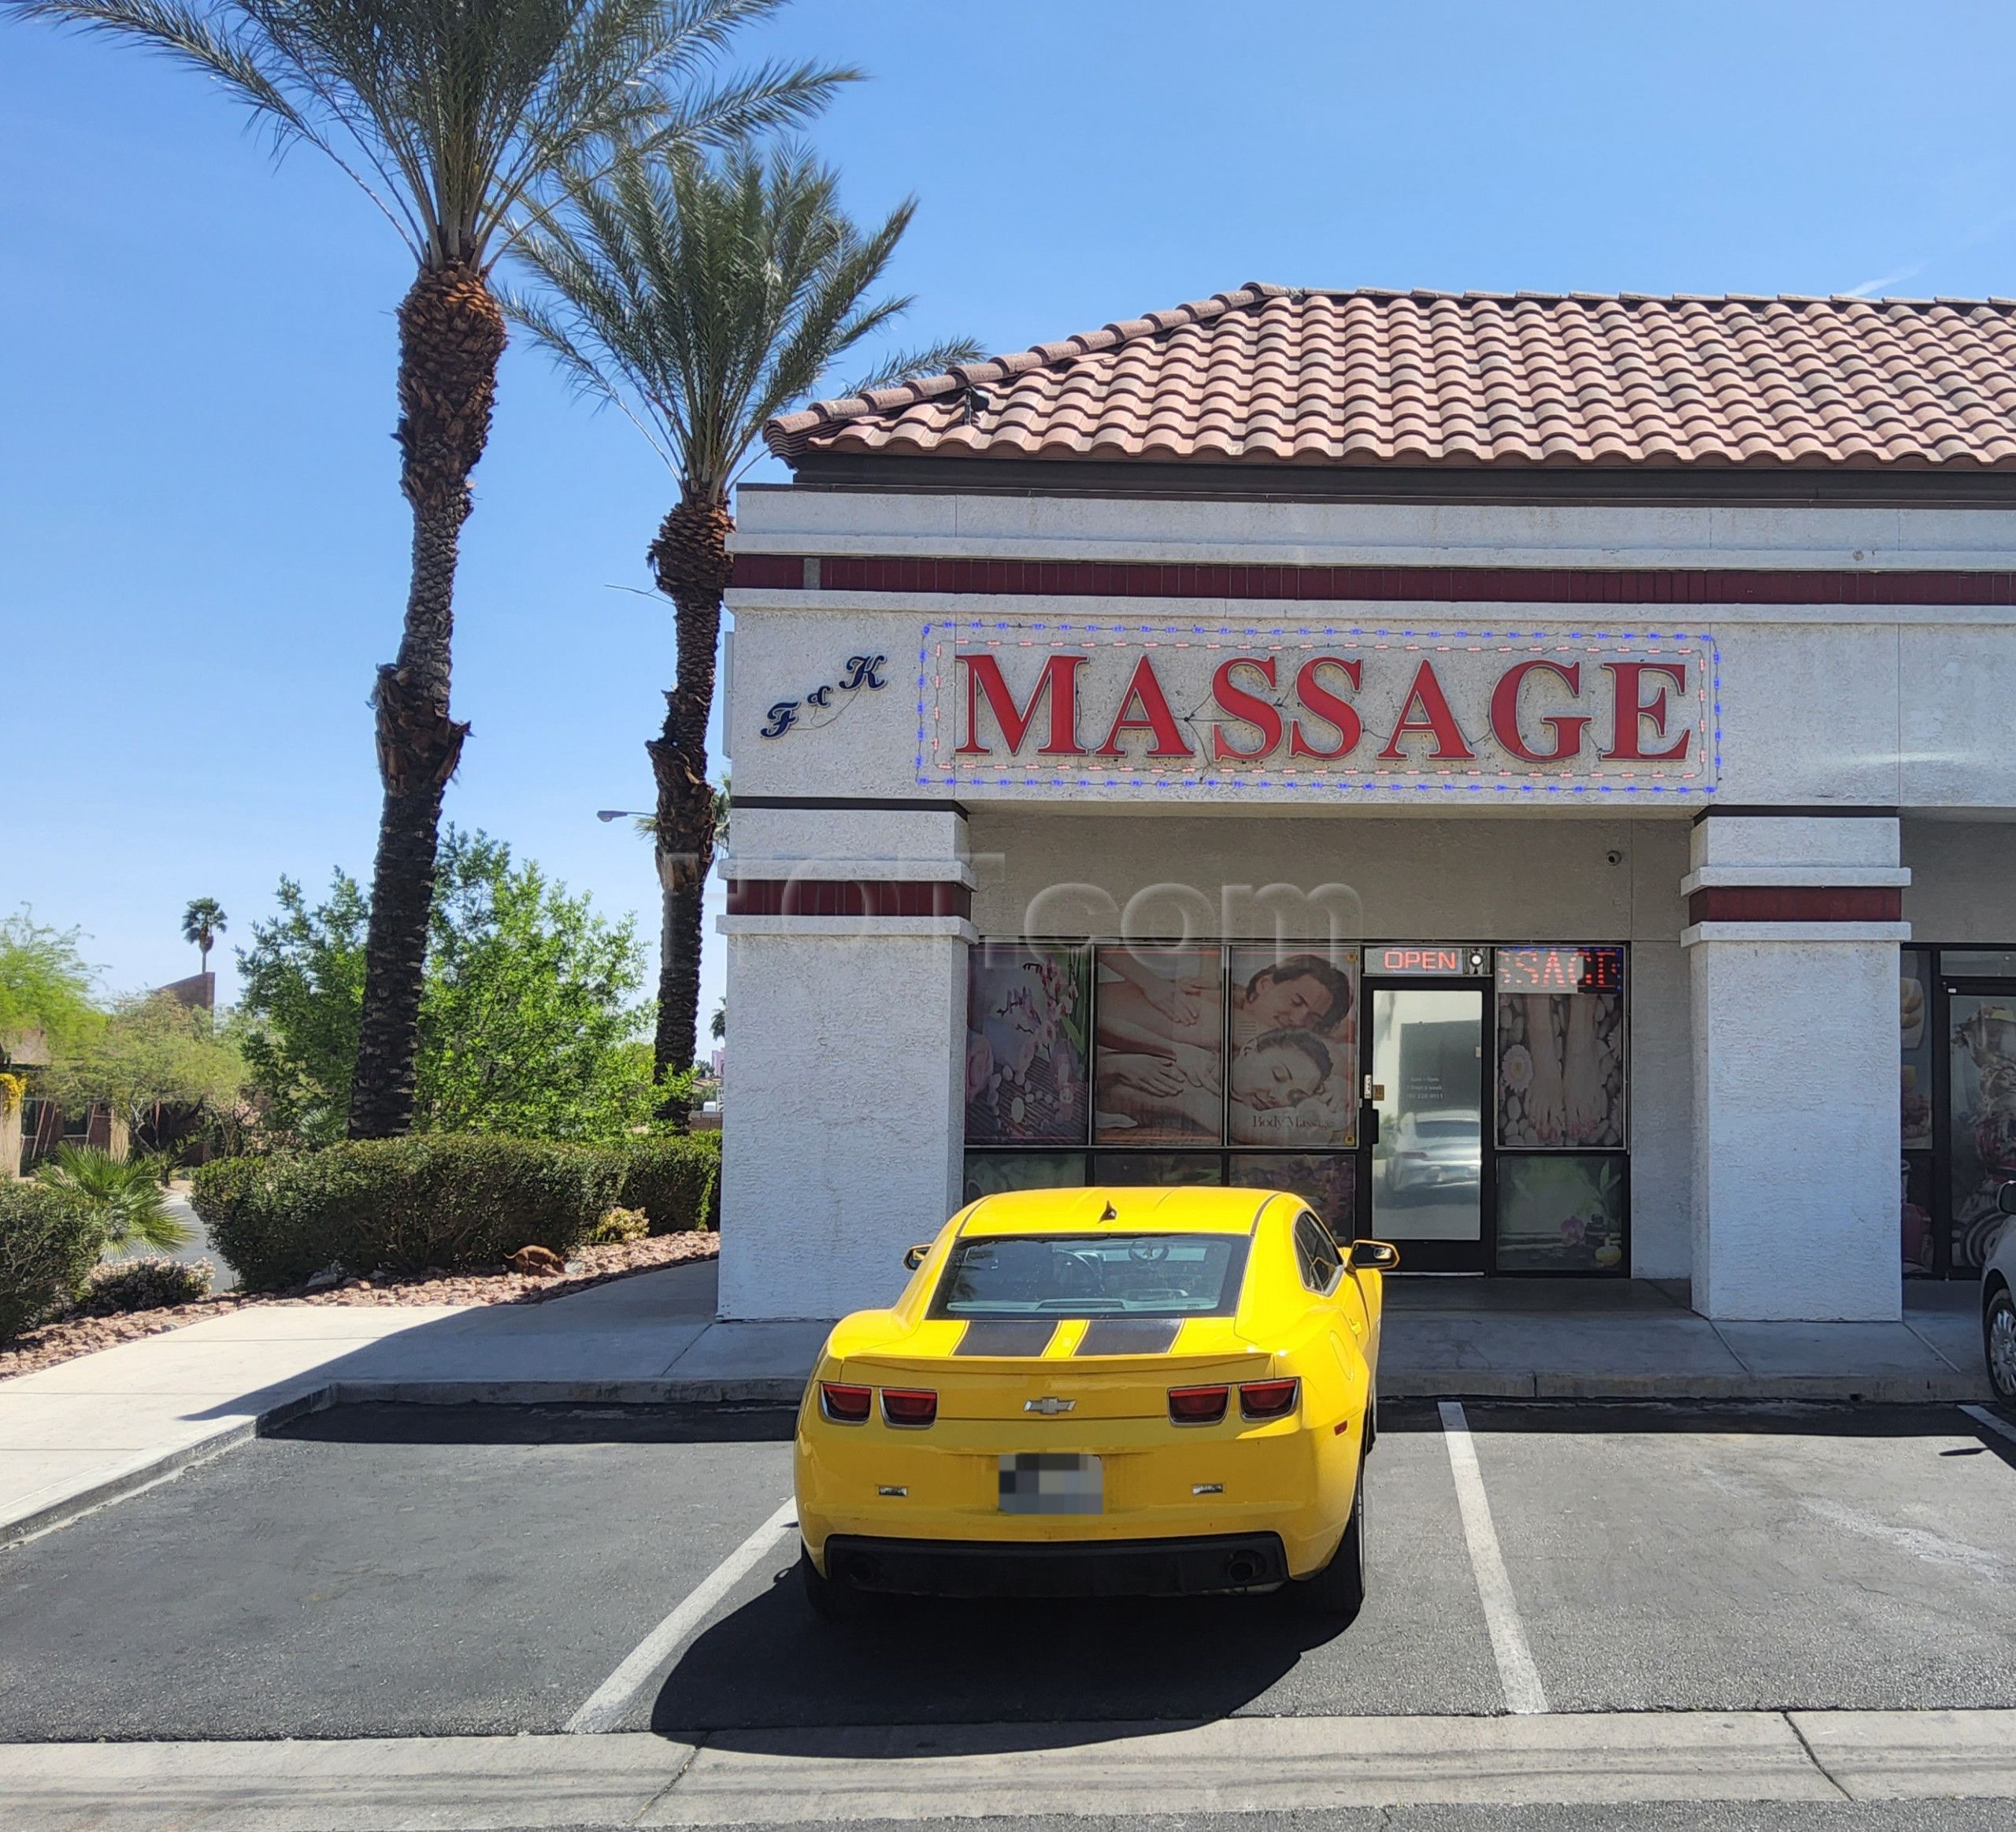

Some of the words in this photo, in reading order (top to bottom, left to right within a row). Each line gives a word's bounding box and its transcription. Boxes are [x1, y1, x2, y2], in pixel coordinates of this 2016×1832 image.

[760, 701, 801, 739] F
[838, 655, 888, 691] K
[954, 653, 1691, 762] MASSAGE
[1384, 950, 1456, 970] OPEN
[1252, 1114, 1281, 1130] Body
